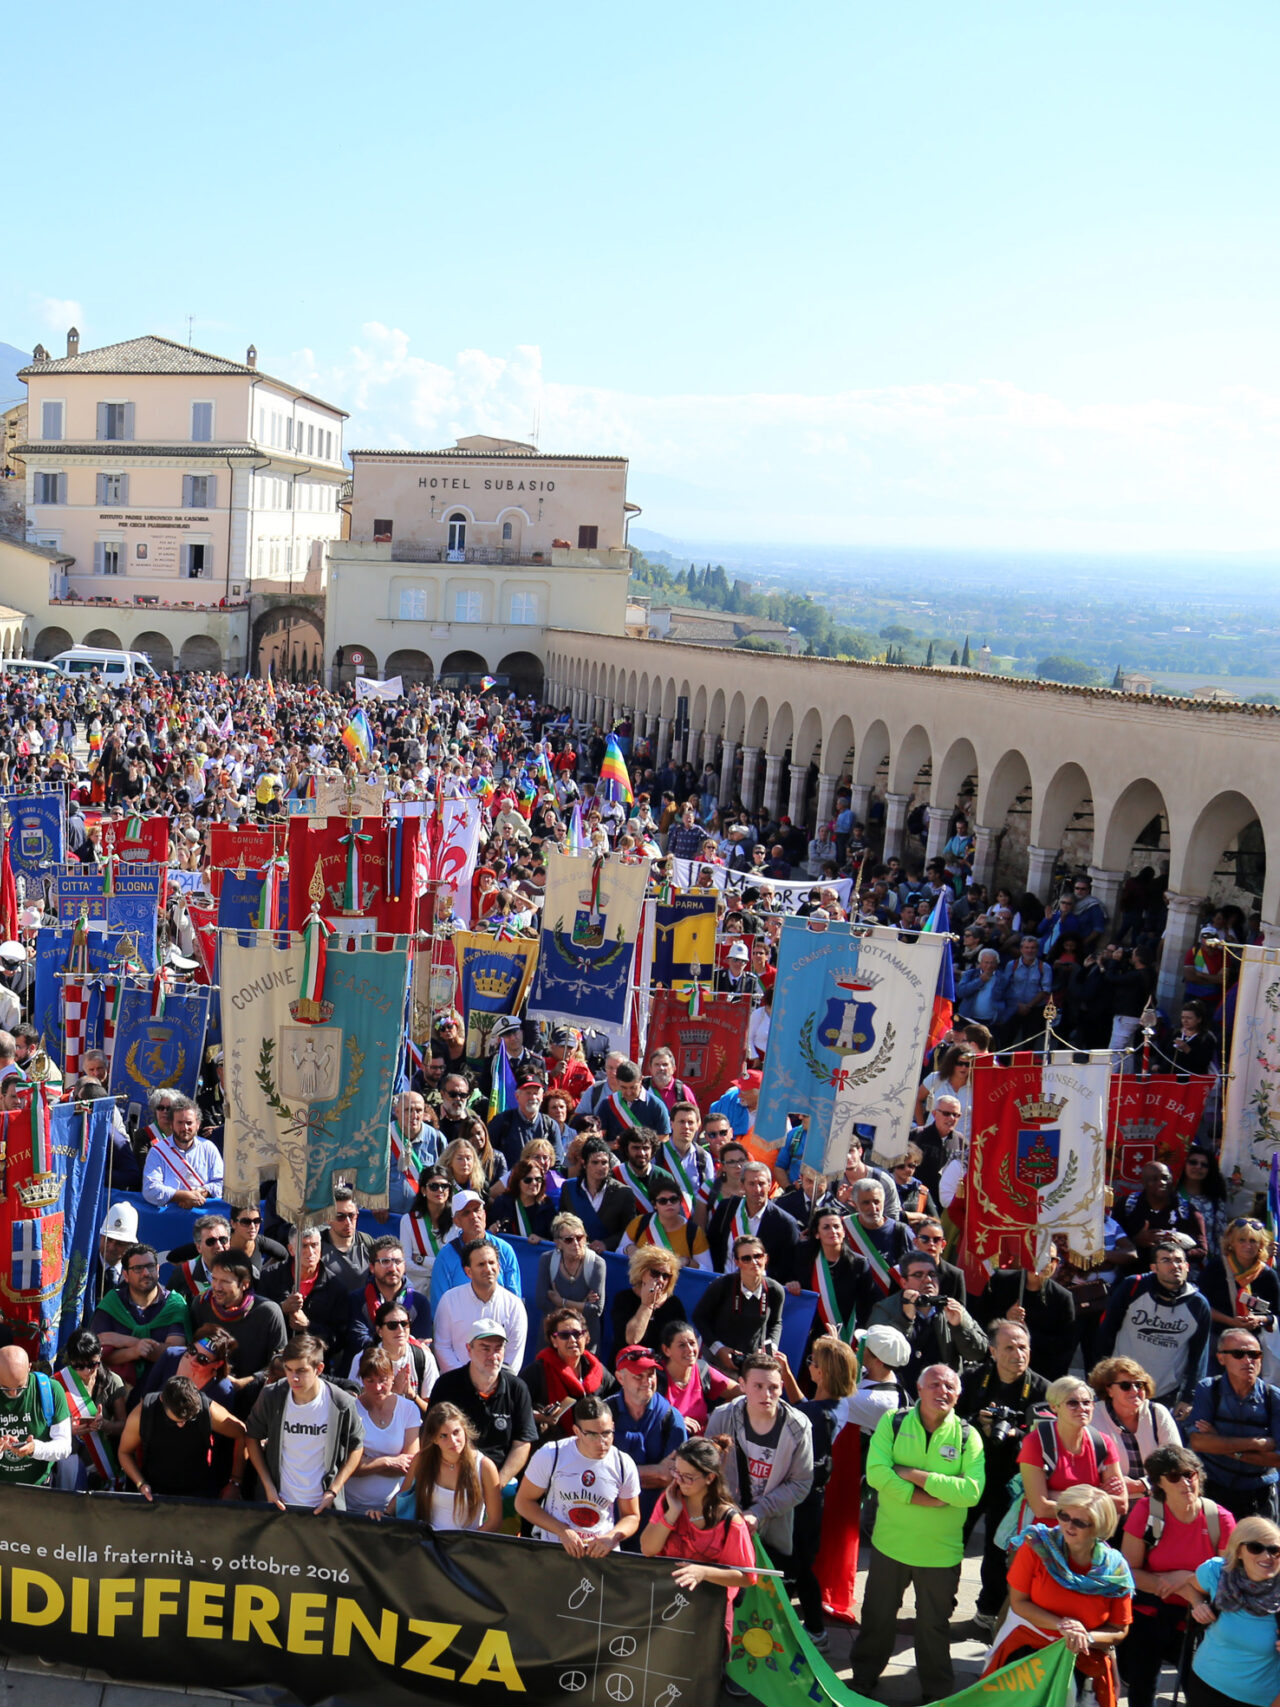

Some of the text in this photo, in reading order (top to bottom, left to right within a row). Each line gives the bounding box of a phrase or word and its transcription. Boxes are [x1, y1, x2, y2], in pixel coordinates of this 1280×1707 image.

[419, 477, 556, 492] HOTEL SUBASIO
[61, 881, 93, 892] CITTA'
[115, 880, 154, 892] OLOGNA
[675, 901, 705, 910] PARMA
[88, 949, 121, 962] ITERBO
[791, 944, 833, 972] COMUNE
[848, 942, 922, 989] GROTTAMMARE
[231, 967, 393, 1016] COMUNE CASCIA
[988, 1071, 1094, 1103] CITTA' DI MONSELICE
[1145, 1093, 1160, 1105] DI
[1165, 1098, 1196, 1123] BRA
[1131, 1309, 1189, 1332] Detroit
[1136, 1333, 1179, 1348] STRENGTH
[22, 1412, 32, 1422] di
[36, 1546, 47, 1558] e
[53, 1542, 98, 1563] della
[104, 1544, 195, 1567] fraternità
[211, 1555, 222, 1572] 9
[228, 1555, 302, 1578] ottobre
[306, 1565, 350, 1584] 2016
